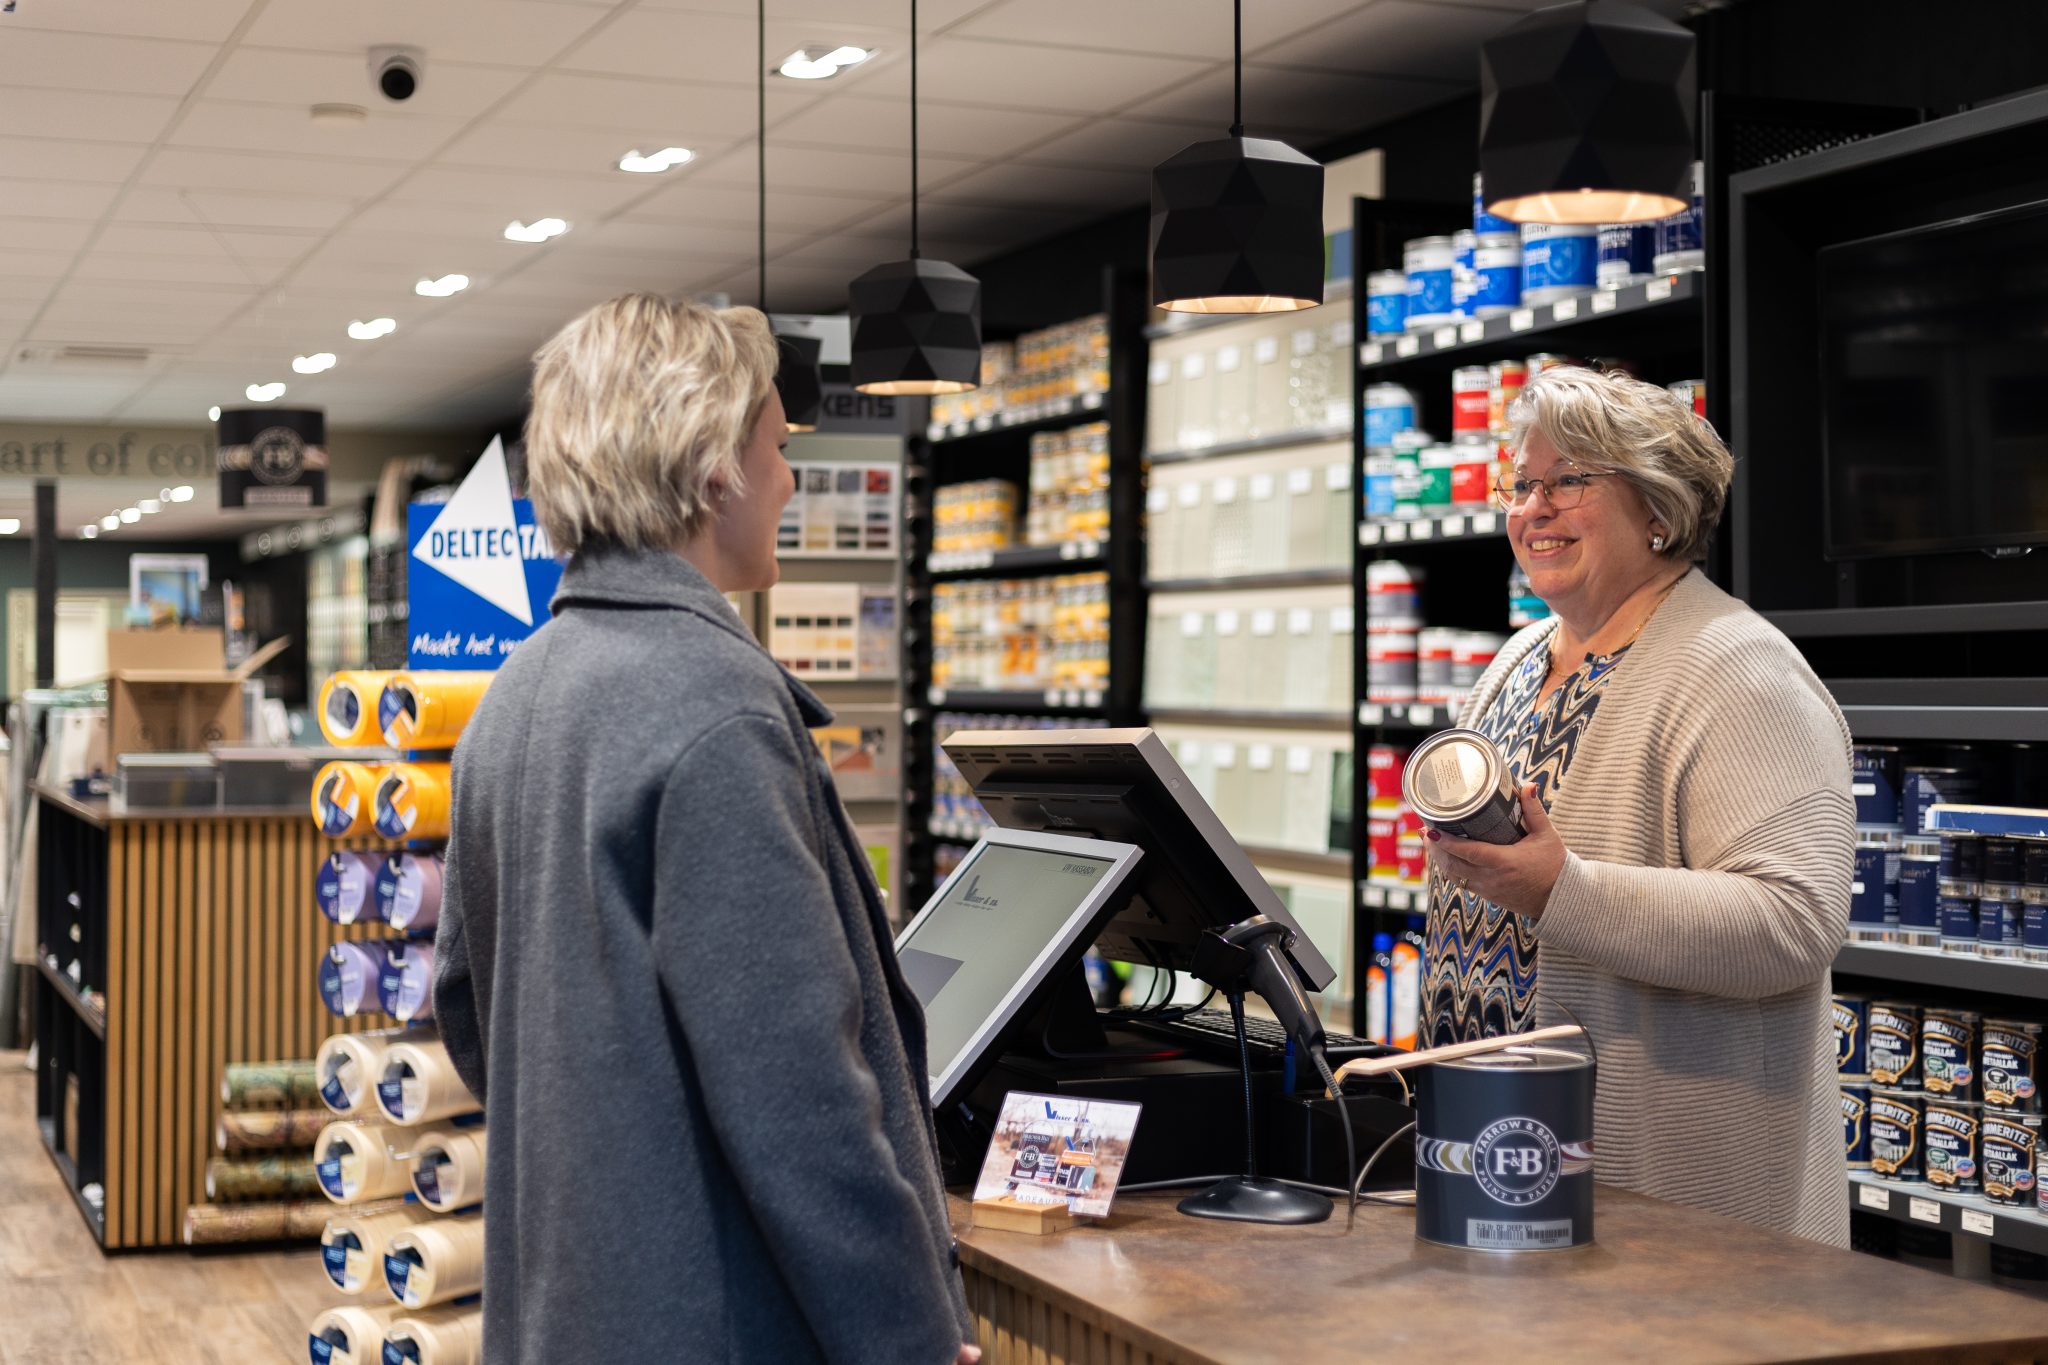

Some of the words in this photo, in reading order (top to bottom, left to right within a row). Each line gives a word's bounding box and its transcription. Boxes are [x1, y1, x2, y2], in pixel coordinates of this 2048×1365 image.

[86, 432, 139, 477] of
[147, 431, 218, 477] col
[431, 529, 514, 558] DELTEC
[518, 524, 562, 560] TA
[1476, 1120, 1521, 1155] FARROW
[1525, 1121, 1534, 1131] &
[1536, 1126, 1557, 1155] BALL
[1494, 1147, 1543, 1175] F&B
[1478, 1170, 1508, 1200] PAINT
[1528, 1171, 1556, 1200] PAPER
